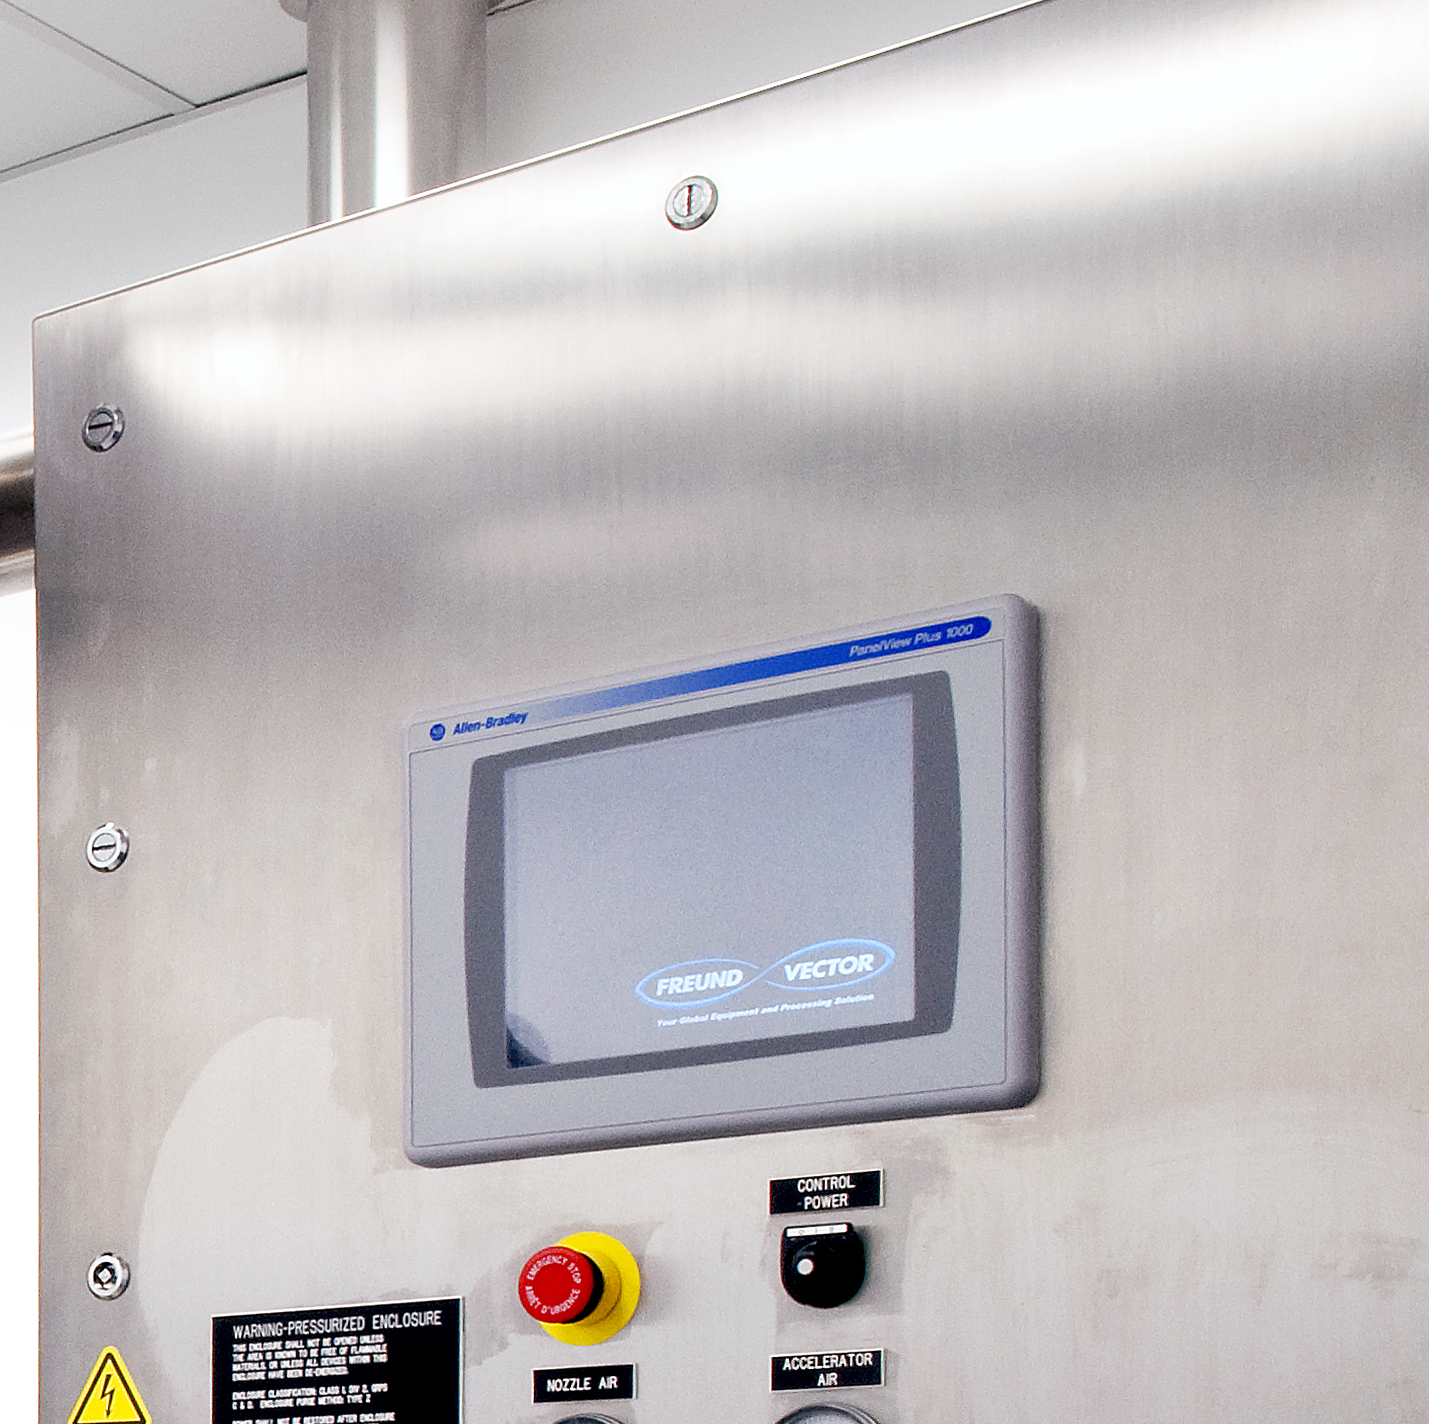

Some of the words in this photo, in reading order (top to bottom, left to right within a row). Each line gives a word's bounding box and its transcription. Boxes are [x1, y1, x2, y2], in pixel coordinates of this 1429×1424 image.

[849, 637, 912, 657] PanelView
[914, 632, 941, 645] Plus
[946, 624, 974, 639] 1000
[453, 712, 529, 735] Allen-Bradley
[656, 969, 743, 996] FREUND
[784, 954, 874, 982] VECTOR
[797, 1175, 856, 1193] CONTROL
[804, 1193, 849, 1210] POWER
[526, 1255, 568, 1280] EMERGENCY
[567, 1262, 582, 1284] STOP
[233, 1316, 366, 1339] WARNING-PRESSURIZED
[372, 1310, 443, 1330] ENCLOSURE
[782, 1352, 874, 1371] ACCELERATOR
[546, 1376, 592, 1393] NOZZLE
[598, 1375, 619, 1390] AIR
[817, 1372, 838, 1387] AIR
